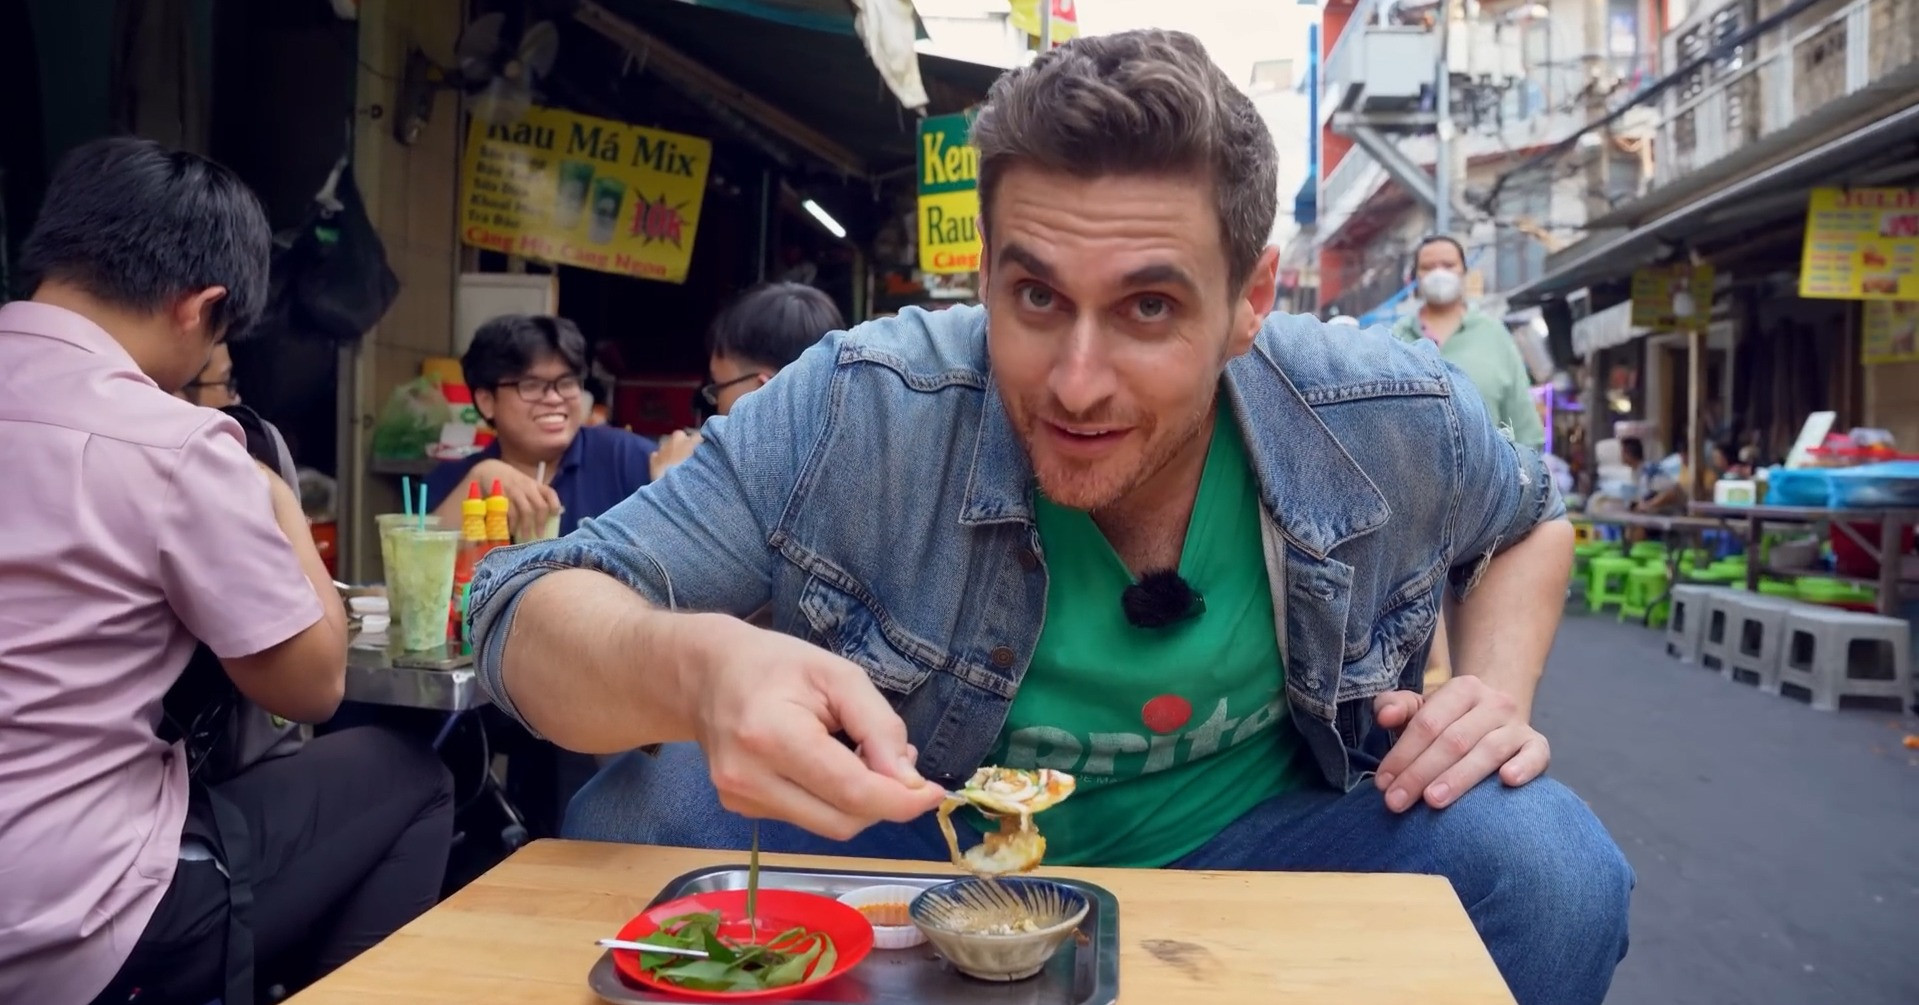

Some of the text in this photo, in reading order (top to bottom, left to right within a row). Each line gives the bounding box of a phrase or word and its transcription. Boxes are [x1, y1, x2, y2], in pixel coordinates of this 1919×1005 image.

[566, 122, 621, 163] Má
[630, 135, 697, 178] Mix
[927, 206, 975, 245] Rau
[1003, 694, 1285, 776] prite
